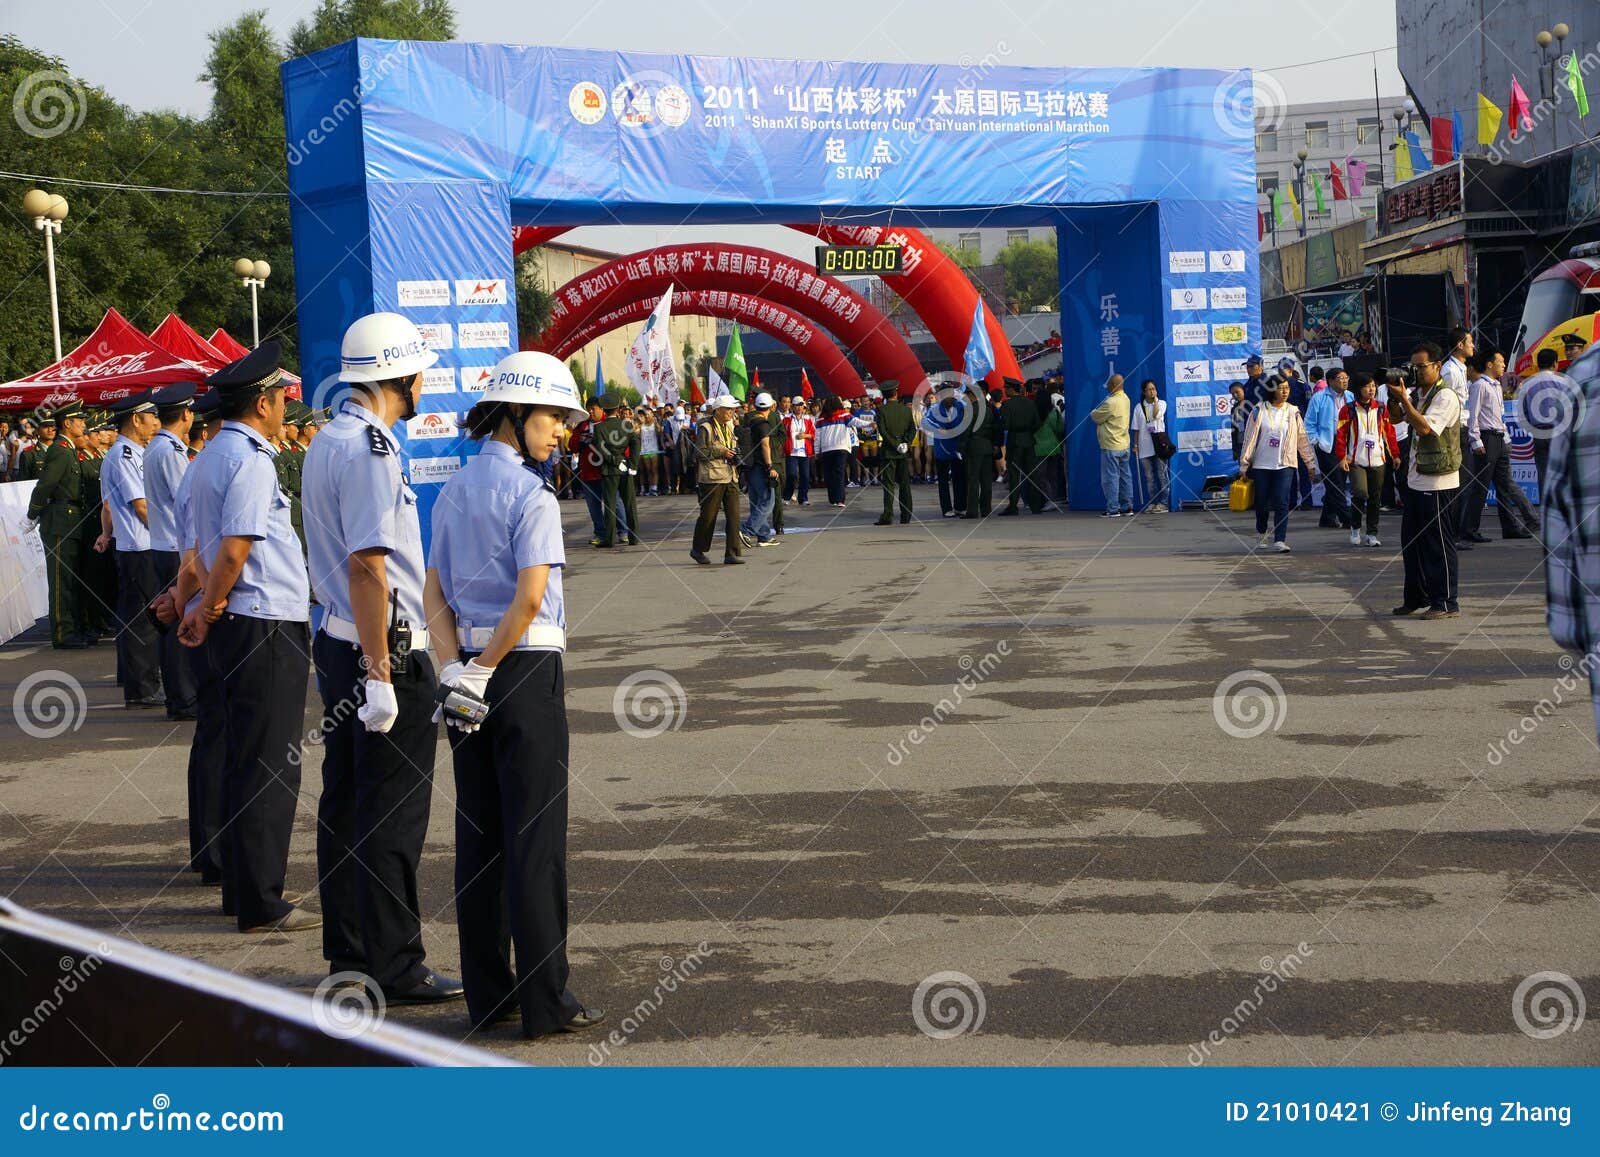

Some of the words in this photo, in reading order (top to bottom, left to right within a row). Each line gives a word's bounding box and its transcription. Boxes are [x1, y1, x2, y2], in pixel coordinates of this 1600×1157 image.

[703, 85, 759, 109] 2011
[931, 89, 1109, 118] 太原国际马拉松赛
[704, 115, 735, 128] 2011
[801, 117, 842, 131] Sports
[845, 118, 889, 132] Lottery
[928, 118, 975, 132] TaiYuan
[978, 119, 1053, 133] International
[1056, 120, 1110, 133] Marathon
[836, 166, 882, 180] START
[825, 249, 897, 271] 0:00:00
[383, 341, 421, 362] POLICE
[499, 371, 543, 390] POLICE
